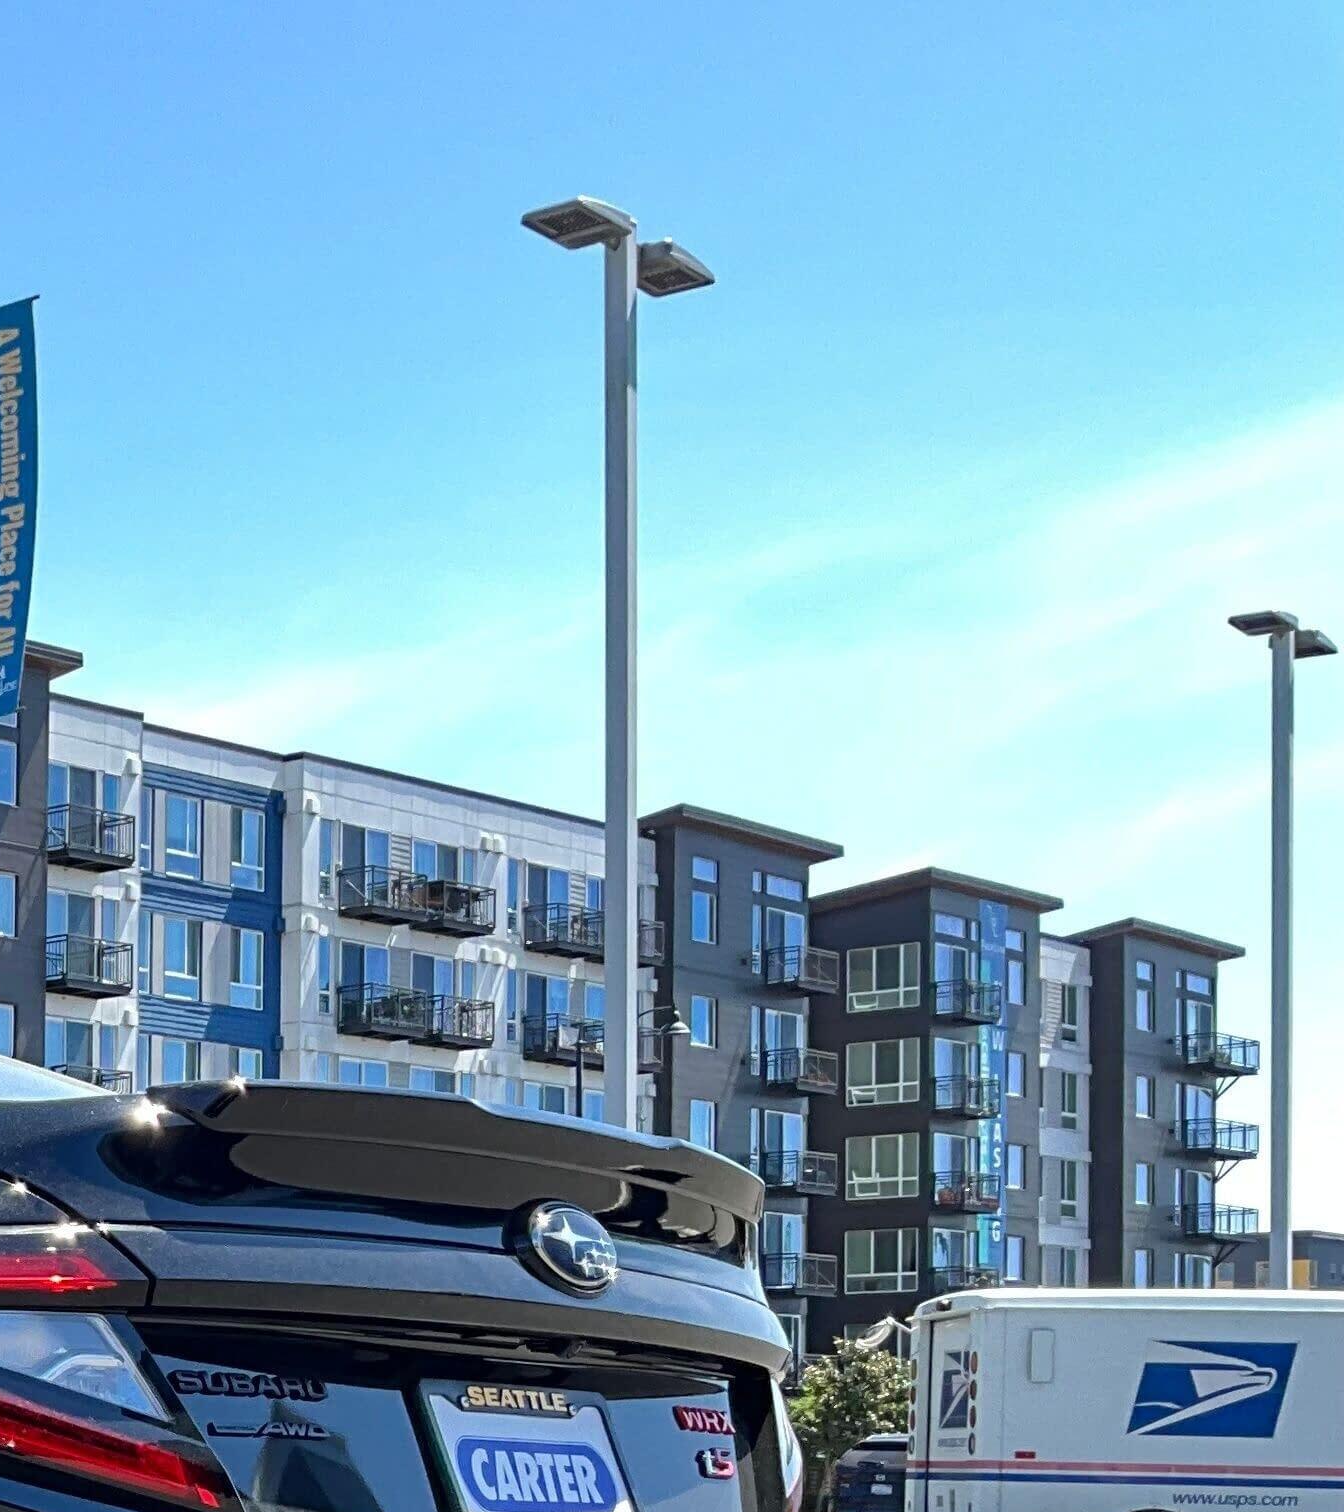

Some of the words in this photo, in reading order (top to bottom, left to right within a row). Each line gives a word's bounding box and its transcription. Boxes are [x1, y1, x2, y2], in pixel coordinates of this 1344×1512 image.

[169, 1370, 328, 1402] SUBARU
[466, 1386, 568, 1413] SEATTLE
[262, 1421, 331, 1439] AWD
[676, 1407, 736, 1434] WRX
[470, 1447, 605, 1505] CARTER
[1172, 1493, 1299, 1510] www.usps.com
